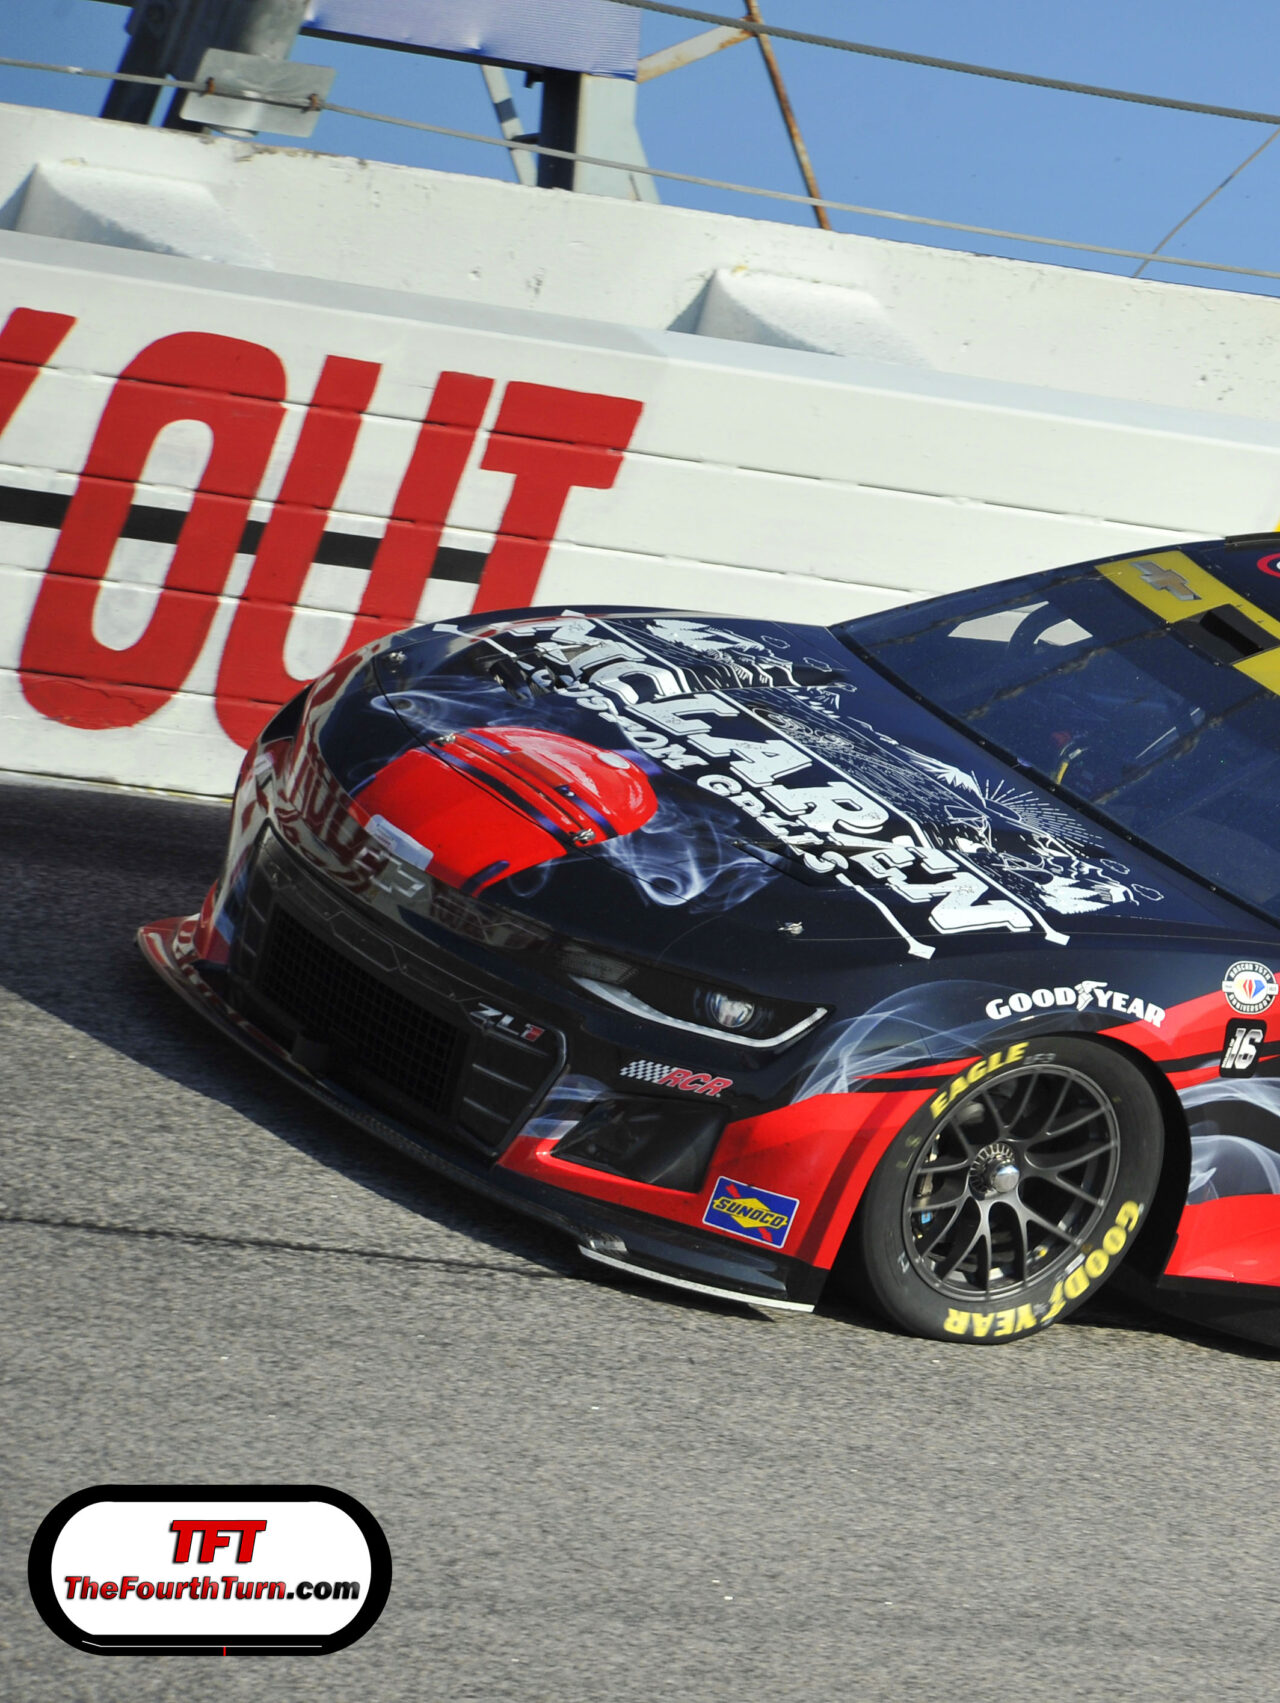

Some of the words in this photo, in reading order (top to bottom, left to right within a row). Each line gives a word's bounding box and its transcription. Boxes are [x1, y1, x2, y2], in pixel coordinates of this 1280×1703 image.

[1225, 1027, 1264, 1070] 16
[657, 1068, 734, 1098] RCR
[930, 1042, 1029, 1119] EAGLE
[716, 1198, 785, 1228] SUNOCO
